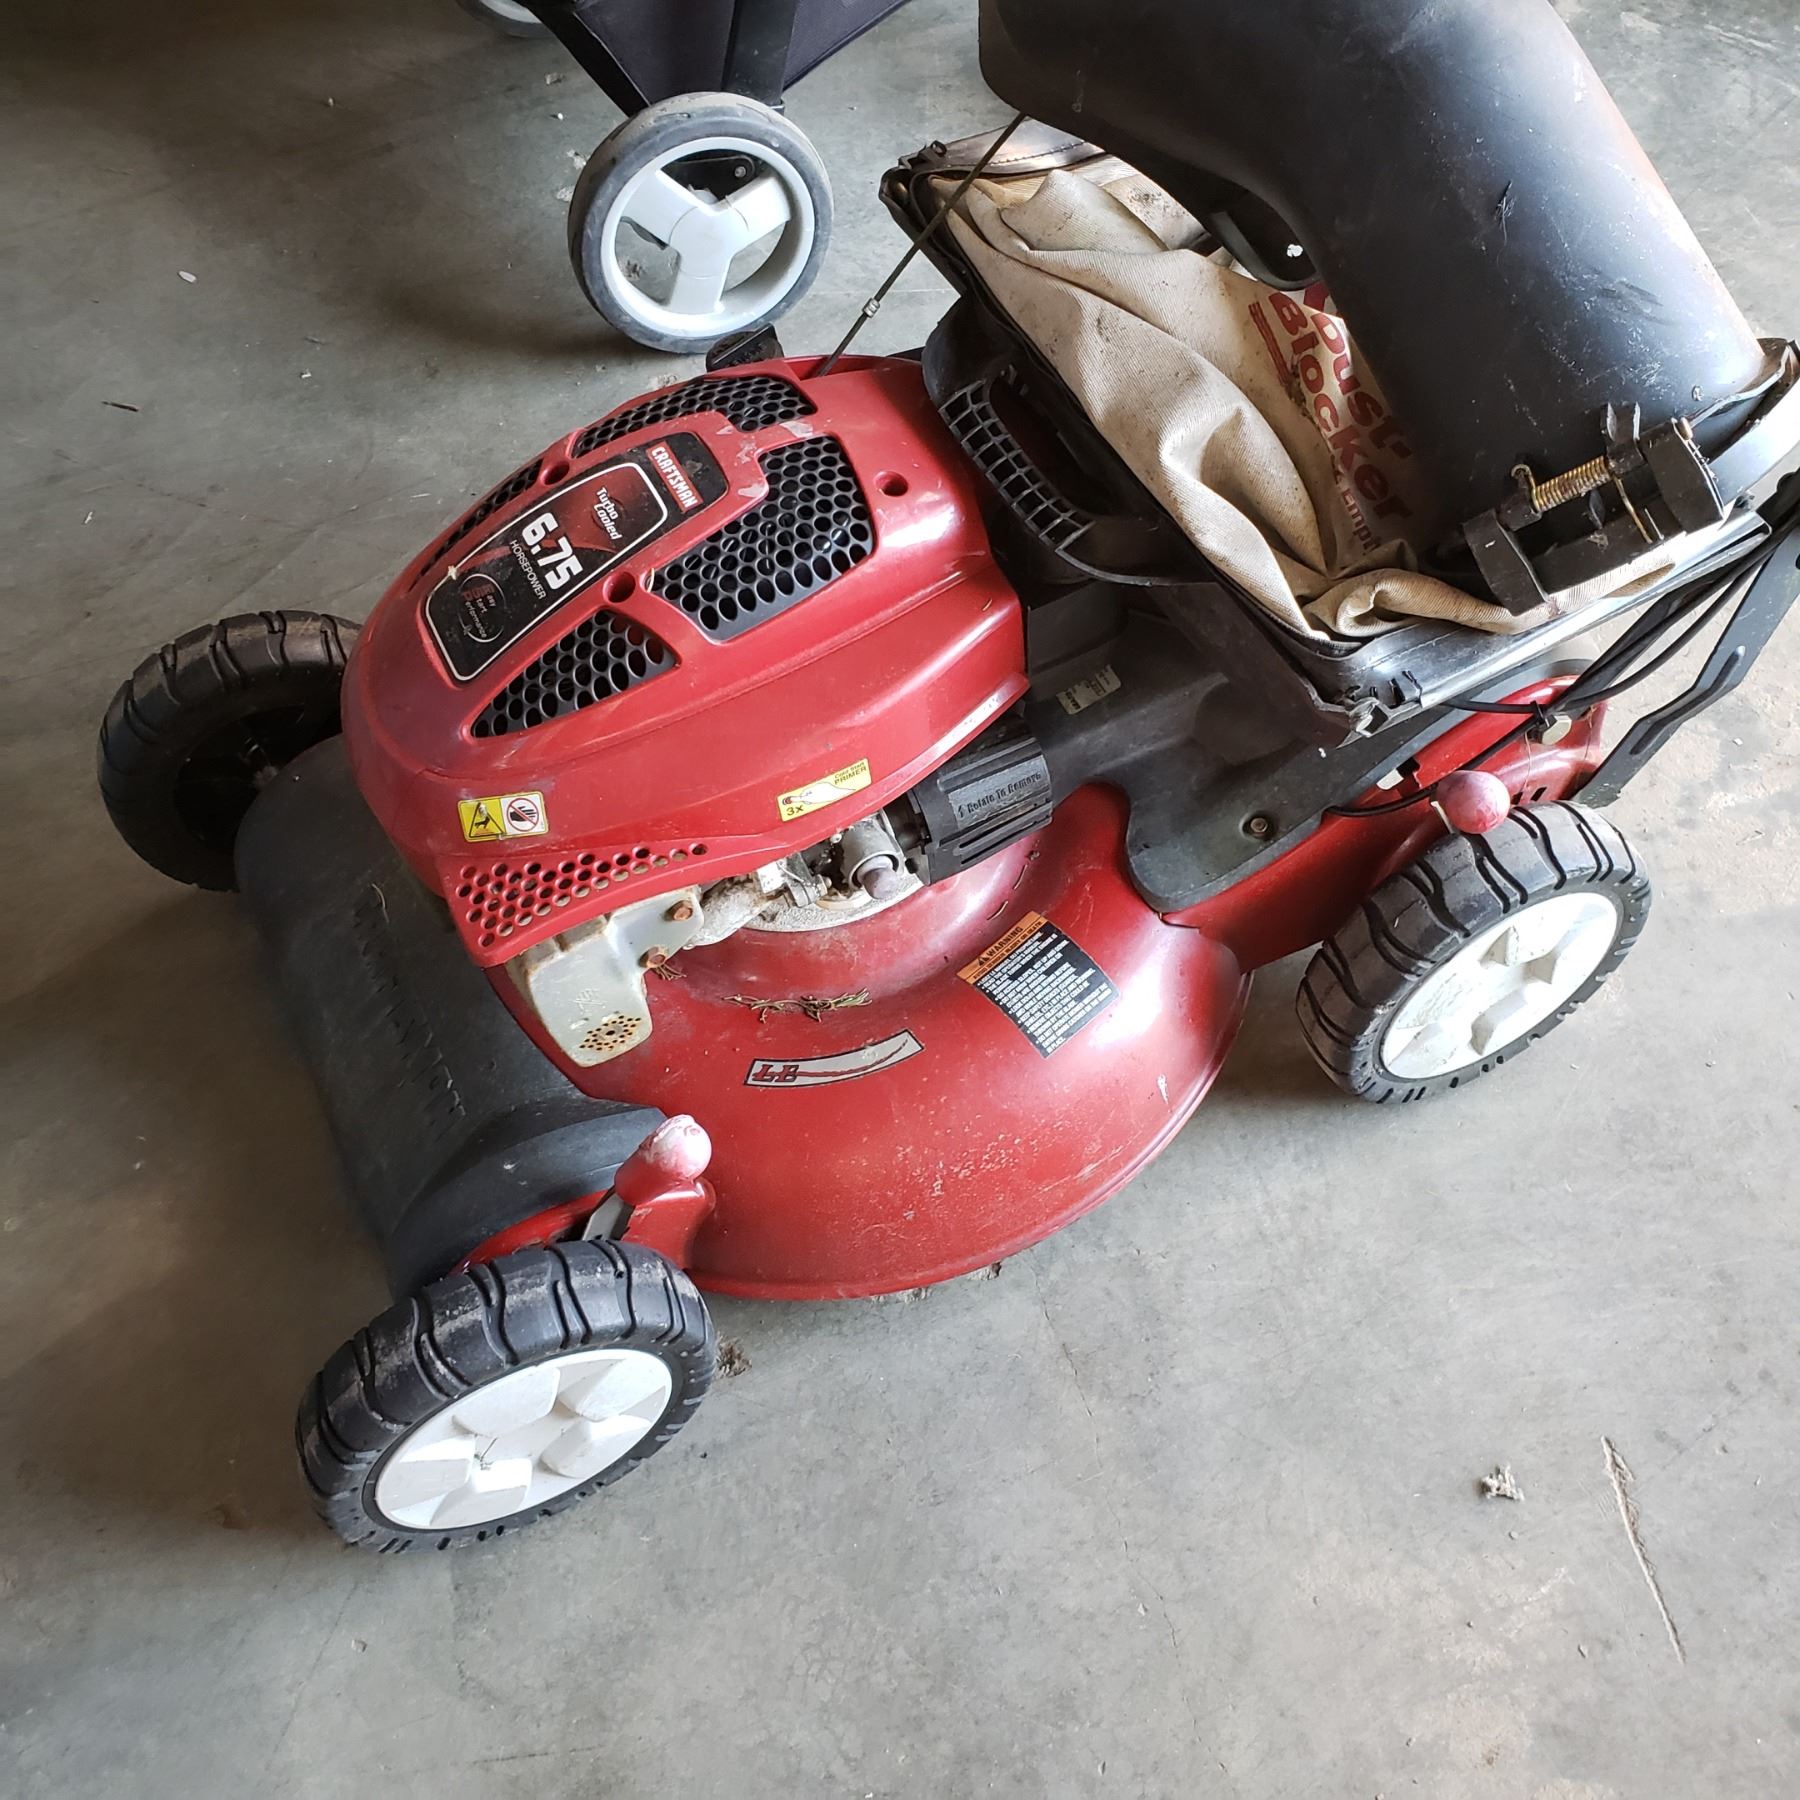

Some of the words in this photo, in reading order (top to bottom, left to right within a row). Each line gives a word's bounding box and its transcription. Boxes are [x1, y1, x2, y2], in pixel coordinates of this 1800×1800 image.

[1268, 291, 1413, 519] Blocker
[650, 445, 699, 510] CRAFTSMAN
[593, 503, 623, 541] Cooled
[595, 486, 619, 520] Turbo
[509, 539, 547, 601] HORSEPOWER
[521, 512, 584, 591] 6.75
[834, 765, 867, 785] PRIMER
[786, 804, 804, 816] 3x
[985, 925, 1024, 957] WARNING
